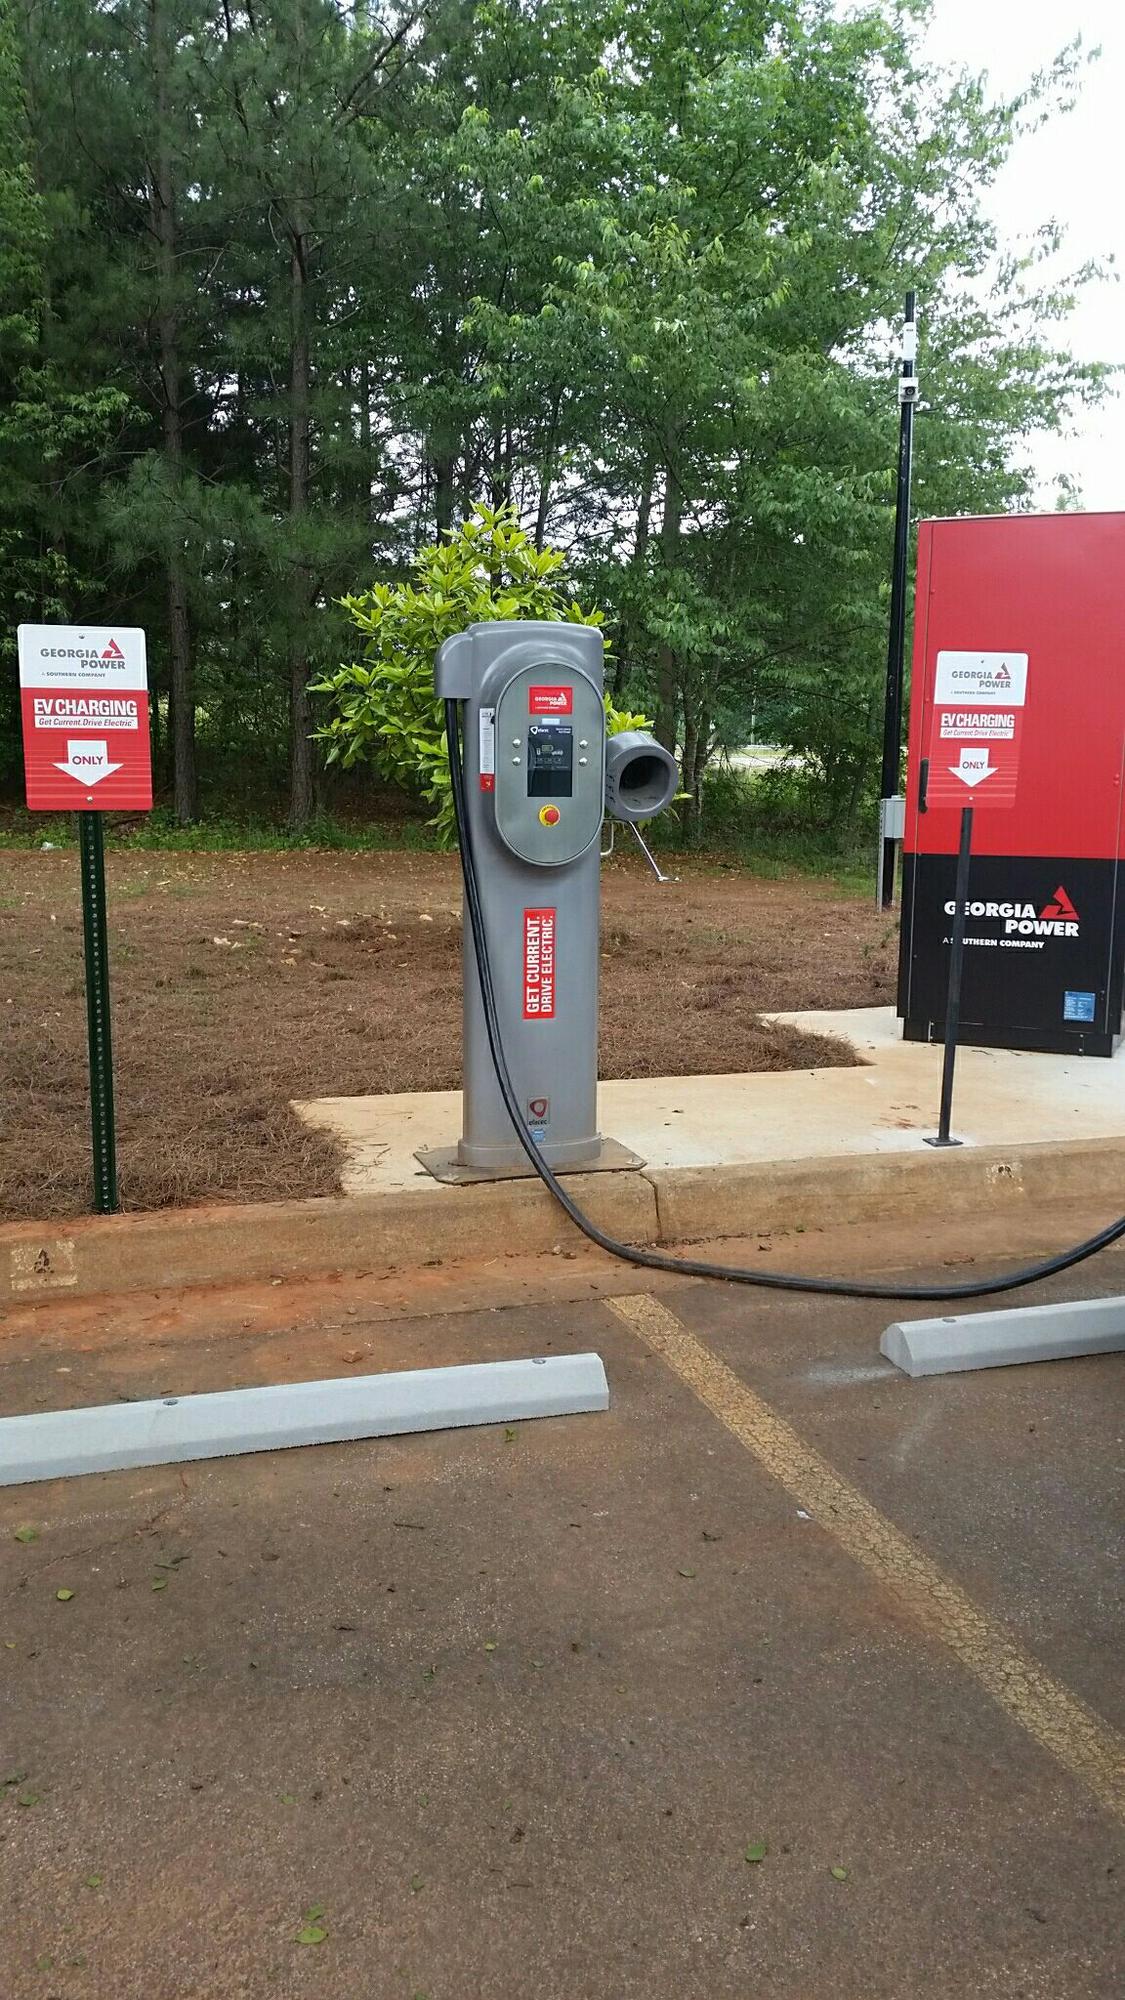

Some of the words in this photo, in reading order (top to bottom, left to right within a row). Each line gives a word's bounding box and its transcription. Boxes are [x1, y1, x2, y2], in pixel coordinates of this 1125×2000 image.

[40, 648, 99, 659] GEORGIA
[80, 660, 126, 670] POWER
[951, 670, 993, 679] GEORGIA
[979, 680, 1011, 688] POWER
[33, 698, 53, 714] EV
[54, 699, 138, 716] CHARGING
[38, 717, 52, 726] Get
[82, 718, 103, 727] Drive
[940, 713, 956, 726] EV
[956, 714, 1015, 728] CHARGING
[72, 755, 104, 765] ONLY
[962, 761, 985, 769] ONLY
[1005, 919, 1080, 937] POWER
[541, 915, 553, 974] ELECTRIC.
[950, 937, 998, 947] UTHERN
[999, 939, 1045, 949] COMPANY
[526, 916, 540, 983] CURRENT.
[526, 985, 540, 1013] GET
[541, 977, 553, 1013] DRIVE
